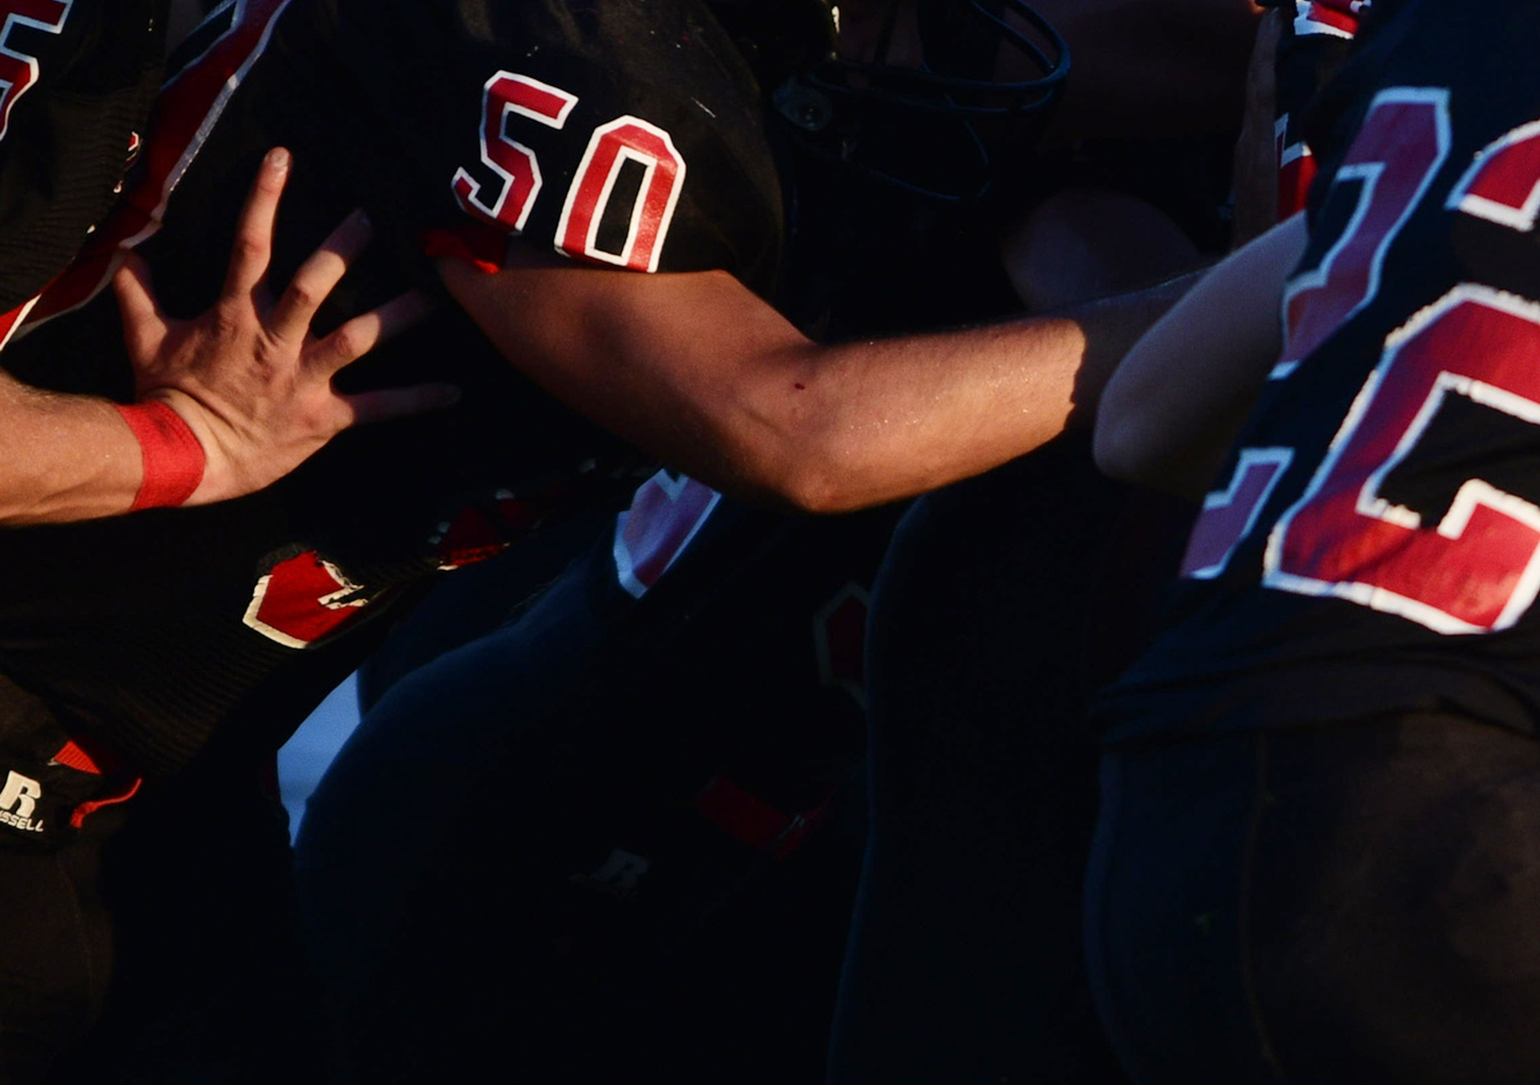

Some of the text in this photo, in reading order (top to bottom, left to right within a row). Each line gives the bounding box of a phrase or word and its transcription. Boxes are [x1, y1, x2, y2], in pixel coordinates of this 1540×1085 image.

[450, 69, 687, 274] 50
[0, 770, 42, 819] R
[0, 810, 44, 833] SSELL
